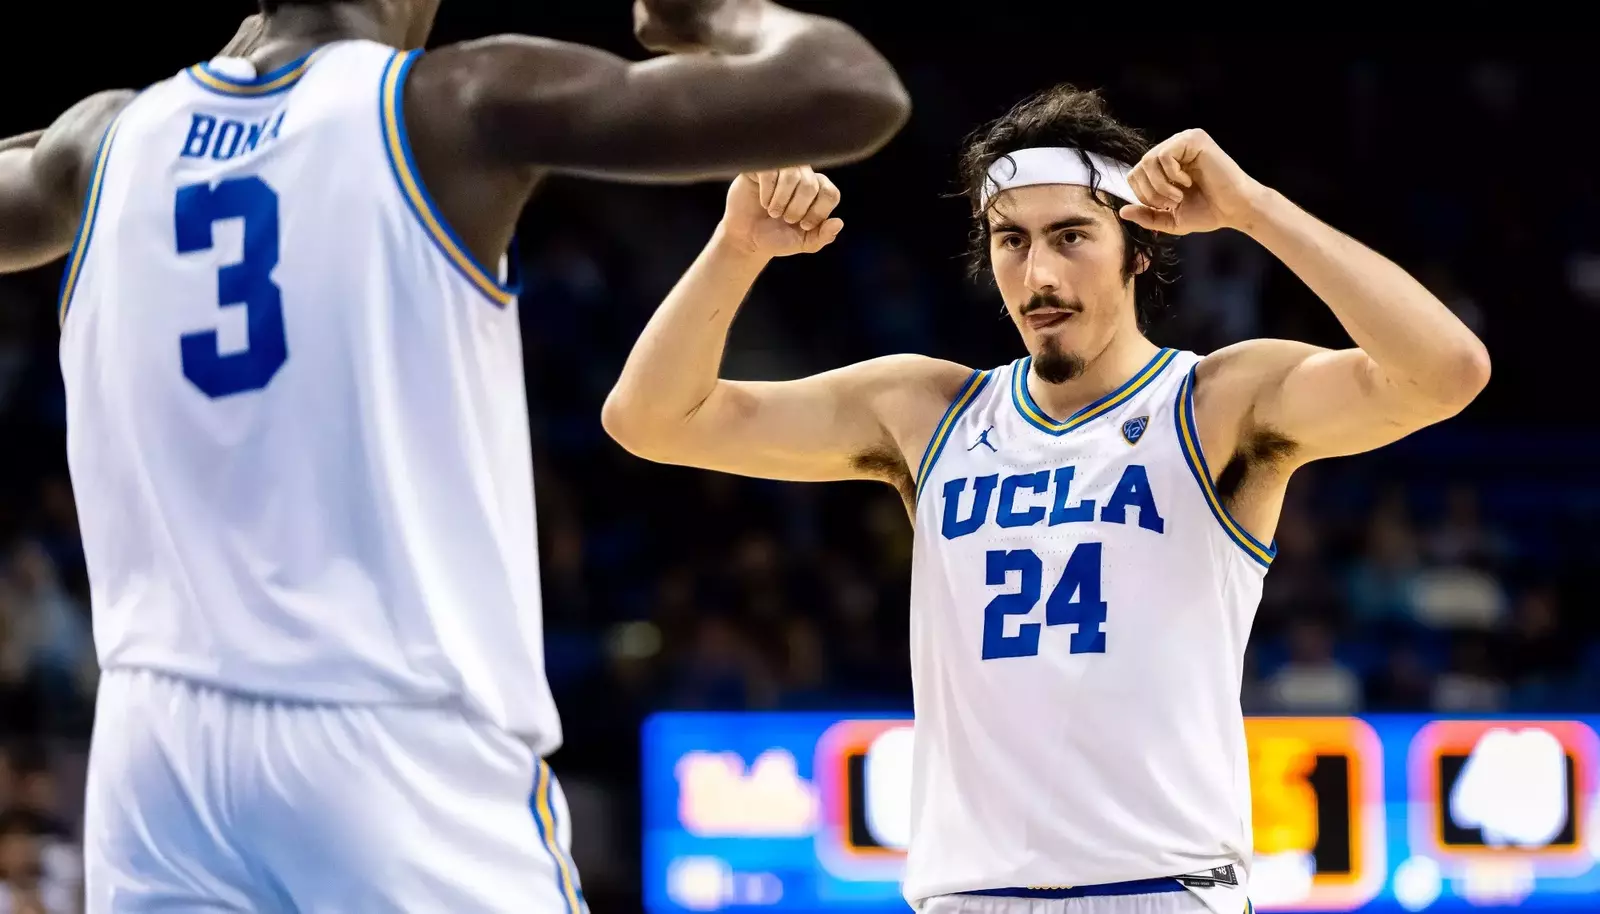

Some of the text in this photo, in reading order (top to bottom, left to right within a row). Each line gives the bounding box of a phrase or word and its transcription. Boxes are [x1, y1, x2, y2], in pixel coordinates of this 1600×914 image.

[175, 175, 288, 399] 3
[1127, 426, 1141, 439] 12
[941, 464, 1165, 540] UCLA
[982, 542, 1107, 660] 24
